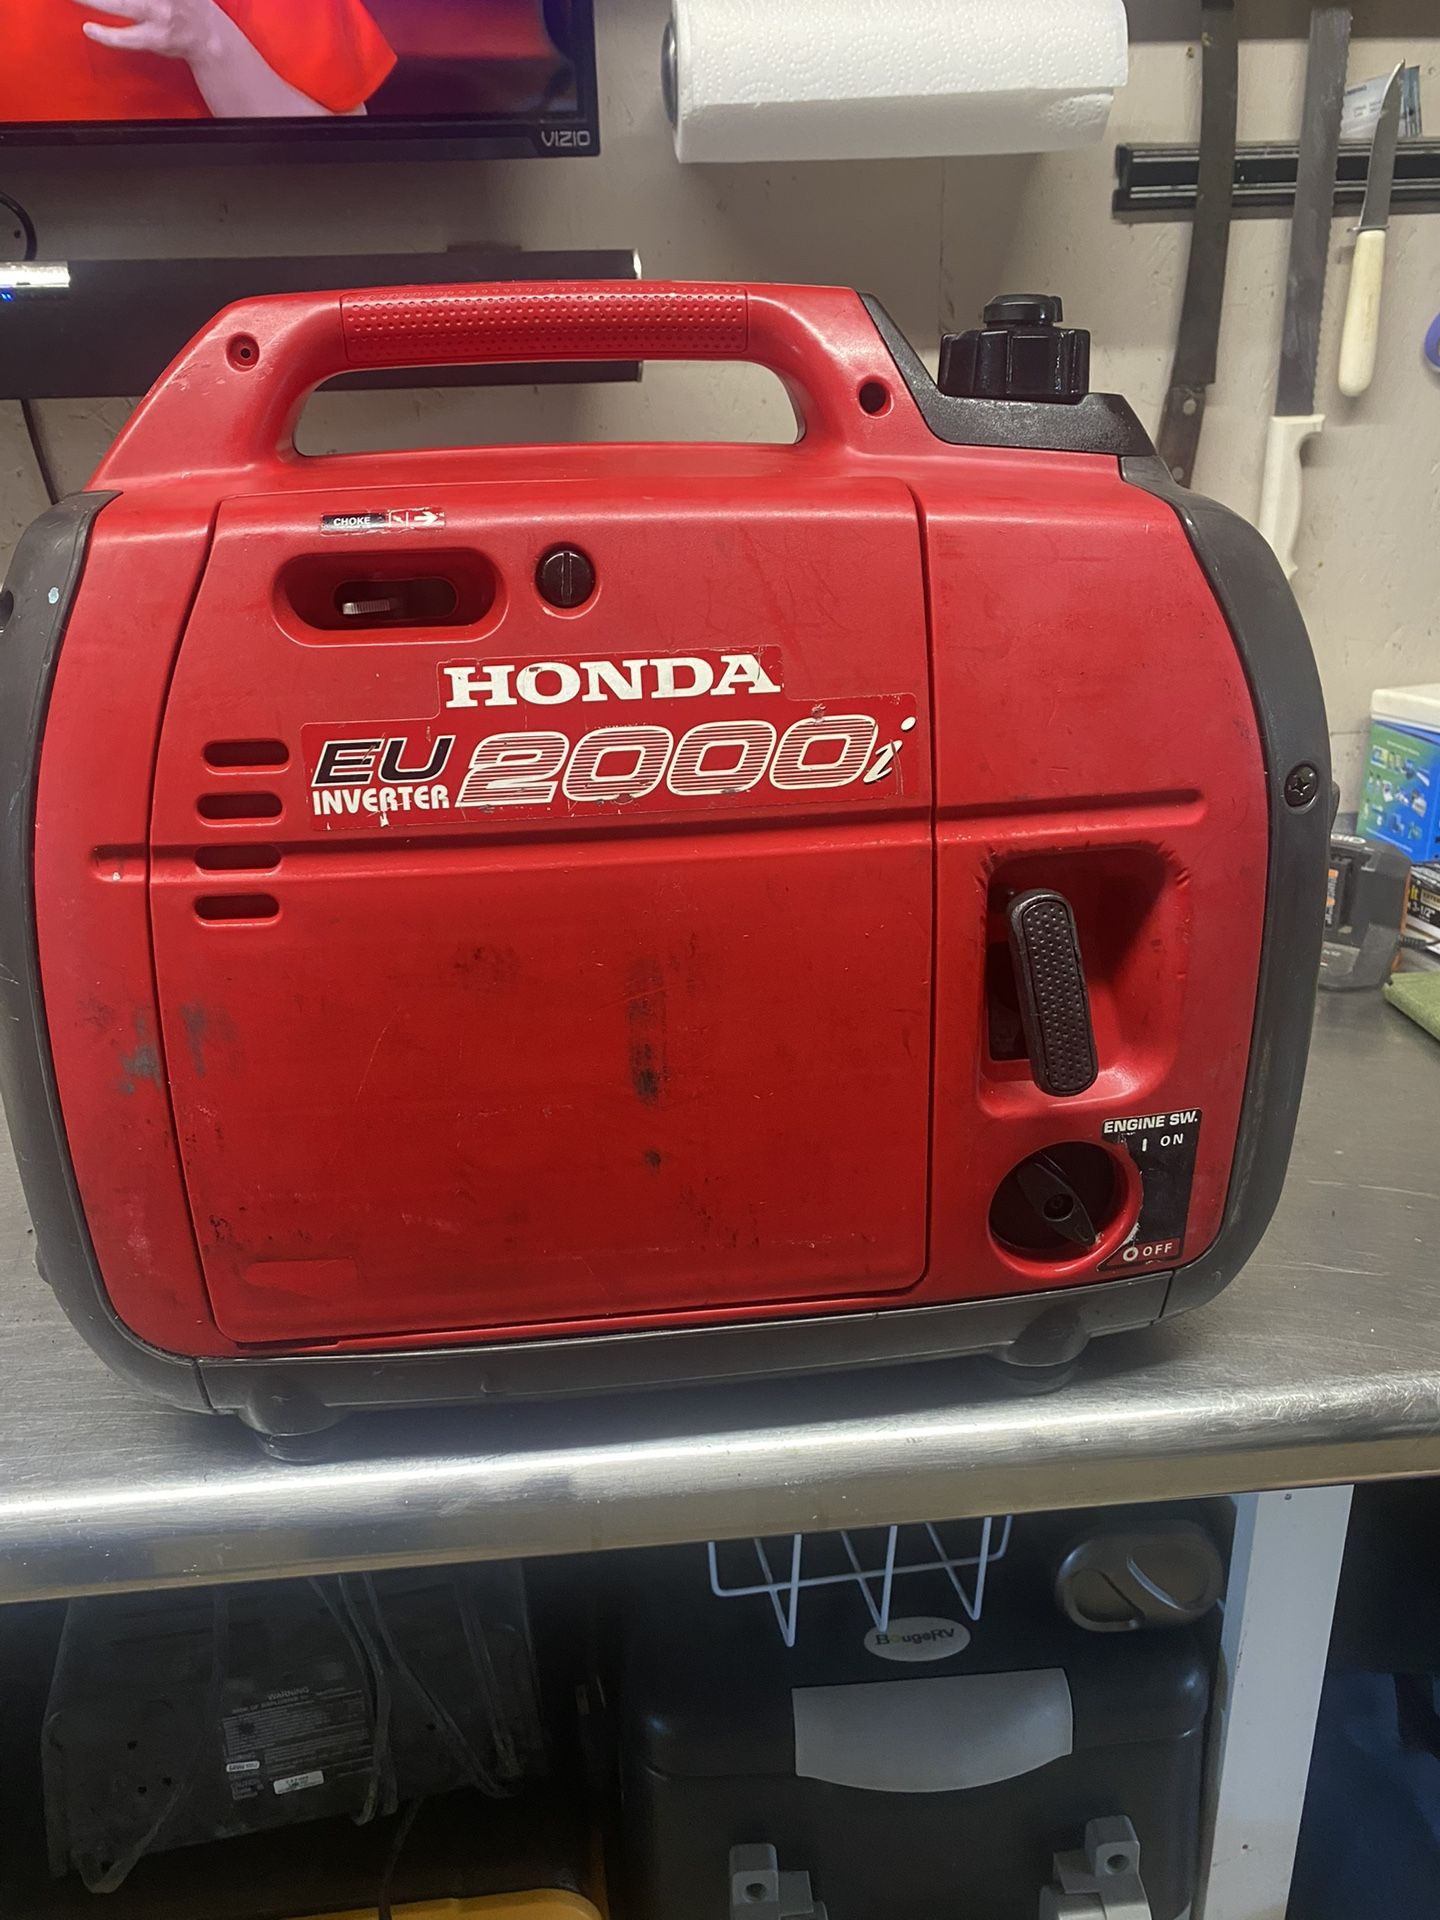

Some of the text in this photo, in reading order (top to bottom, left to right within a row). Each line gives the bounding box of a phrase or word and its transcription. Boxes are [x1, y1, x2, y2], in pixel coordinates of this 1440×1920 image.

[541, 130, 590, 147] VIZIO
[333, 516, 371, 526] CHOKE
[443, 653, 782, 708] HONDA
[310, 714, 917, 808] EU 2000i
[312, 784, 450, 816] INVERTER
[1103, 1110, 1199, 1134] ENGINE SW.
[1160, 1133, 1184, 1147] ON
[1143, 1243, 1173, 1257] OFF
[875, 1628, 955, 1645] BougeRV
